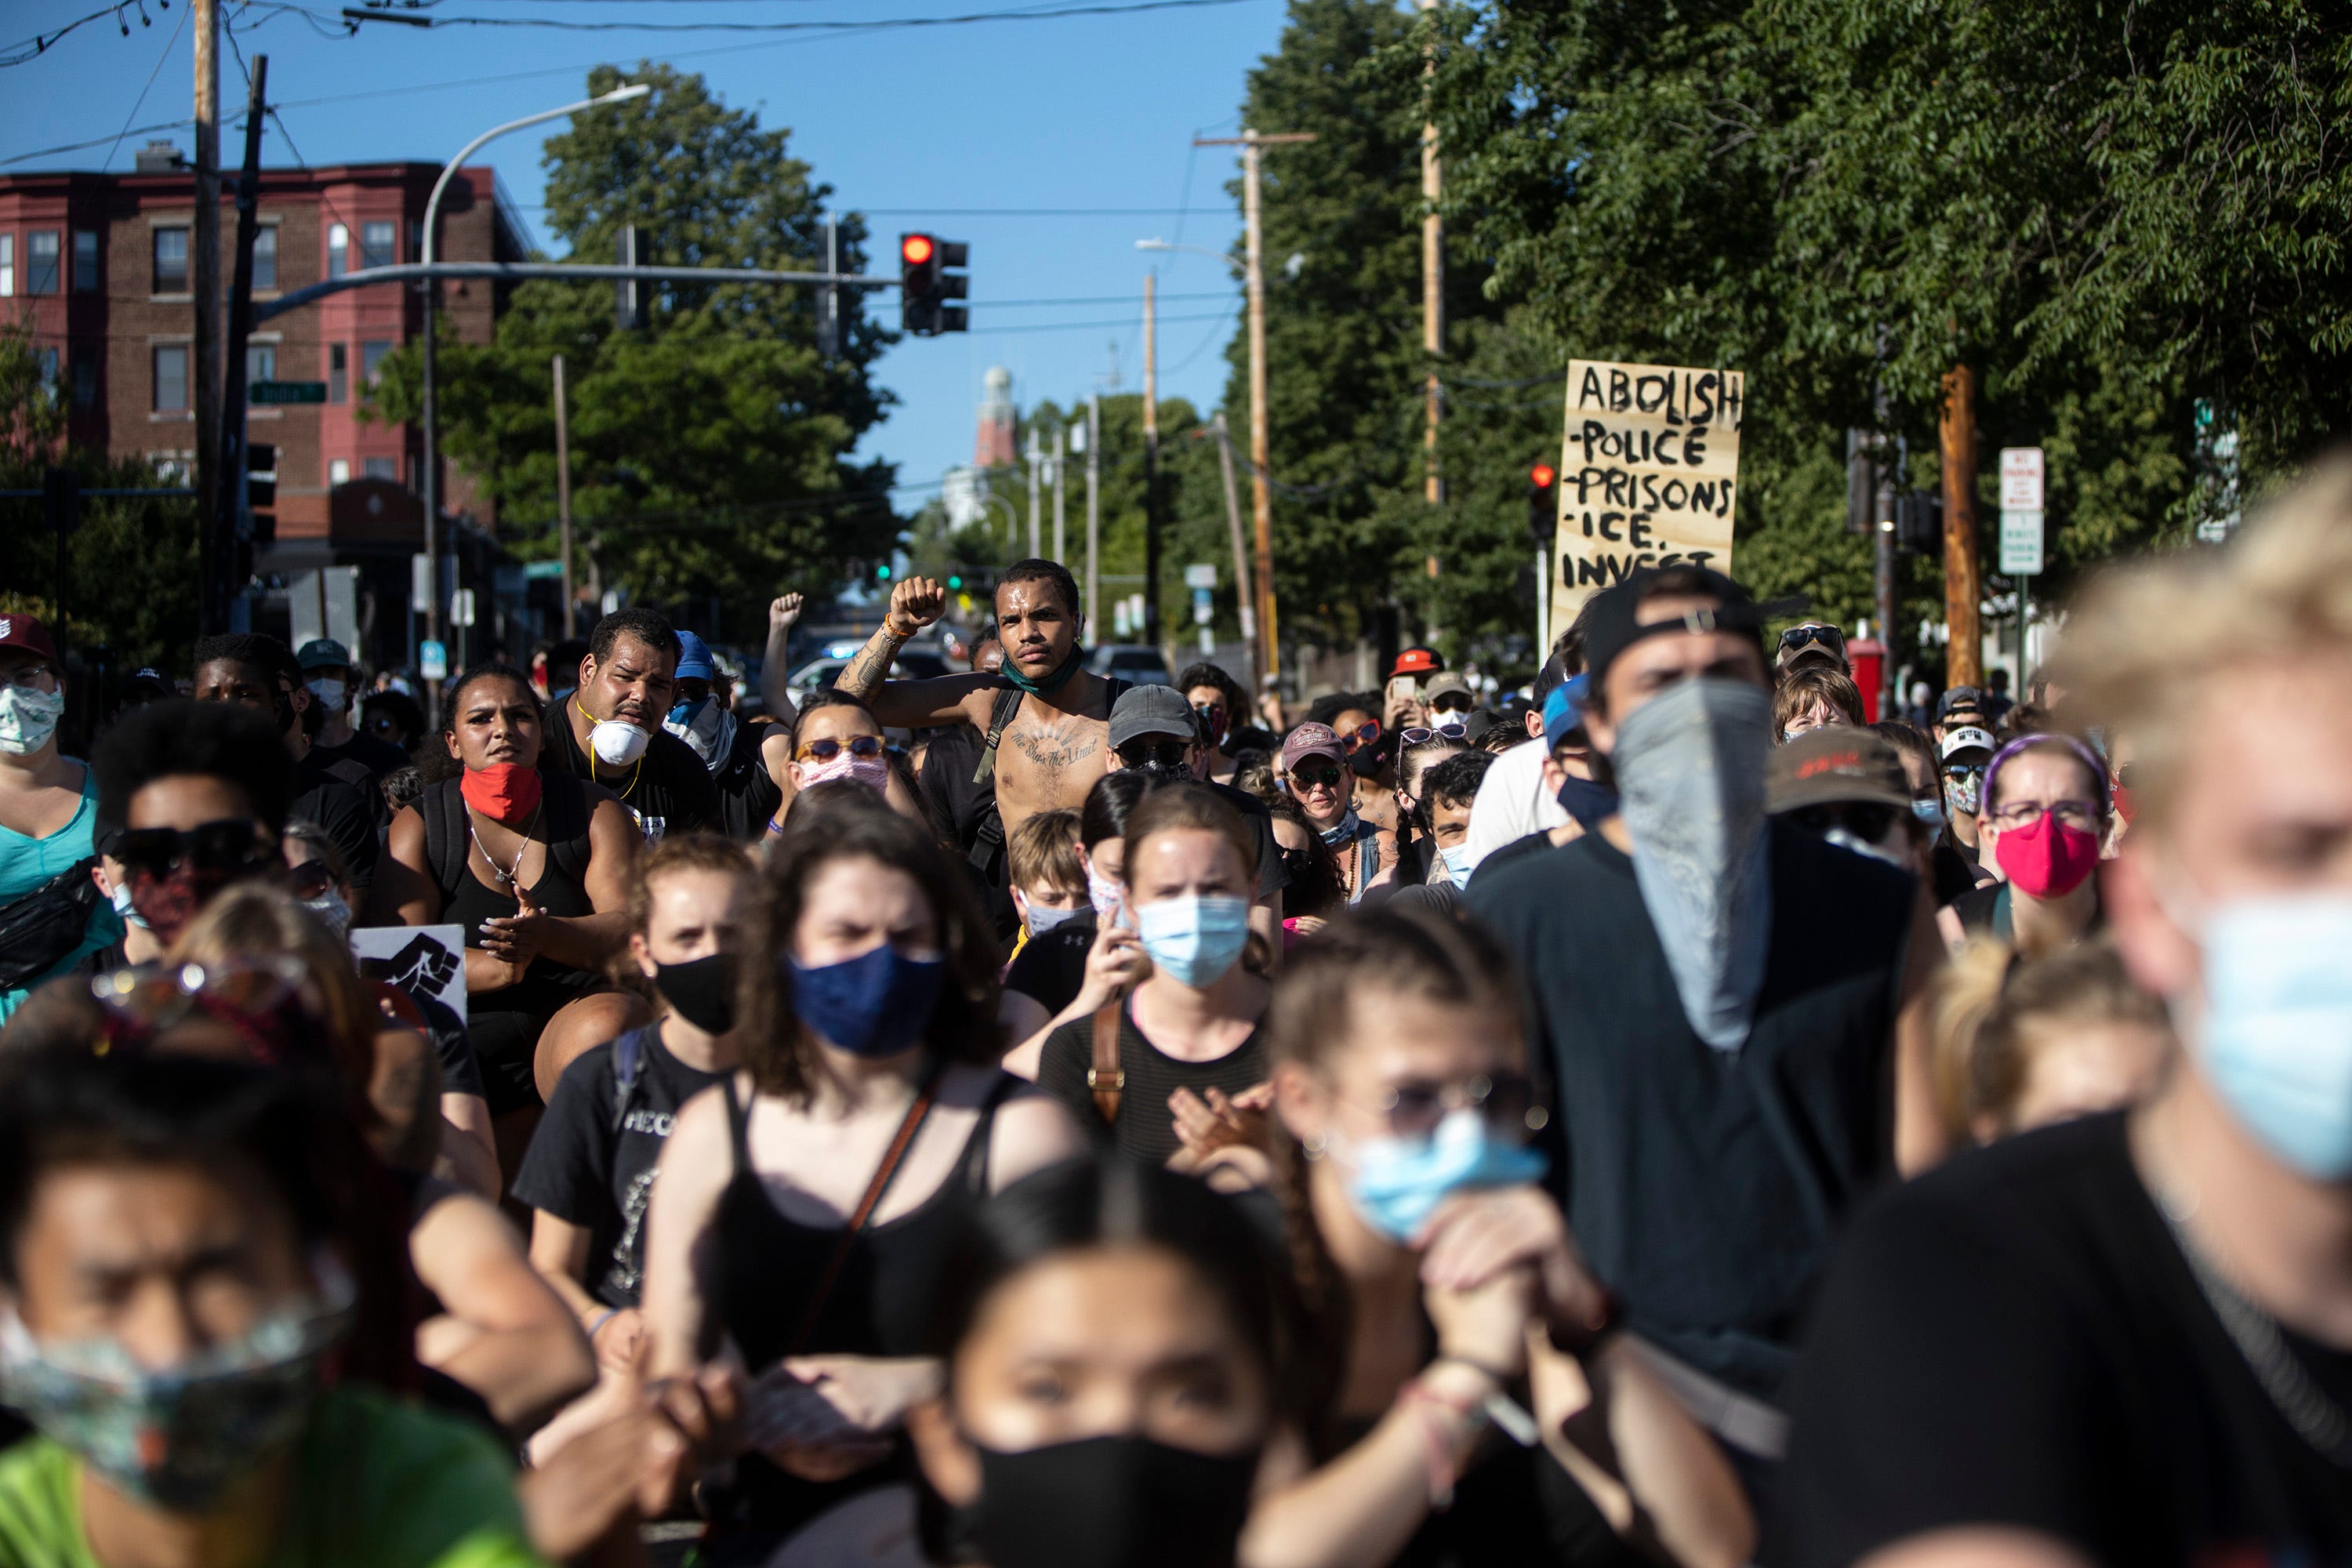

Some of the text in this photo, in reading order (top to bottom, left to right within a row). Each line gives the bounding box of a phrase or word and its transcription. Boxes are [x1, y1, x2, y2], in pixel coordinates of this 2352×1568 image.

[1570, 419, 1708, 465] -POLICE
[1563, 467, 1733, 518] -PRISONS
[1011, 731, 1025, 749] The
[1064, 738, 1097, 765] Limit
